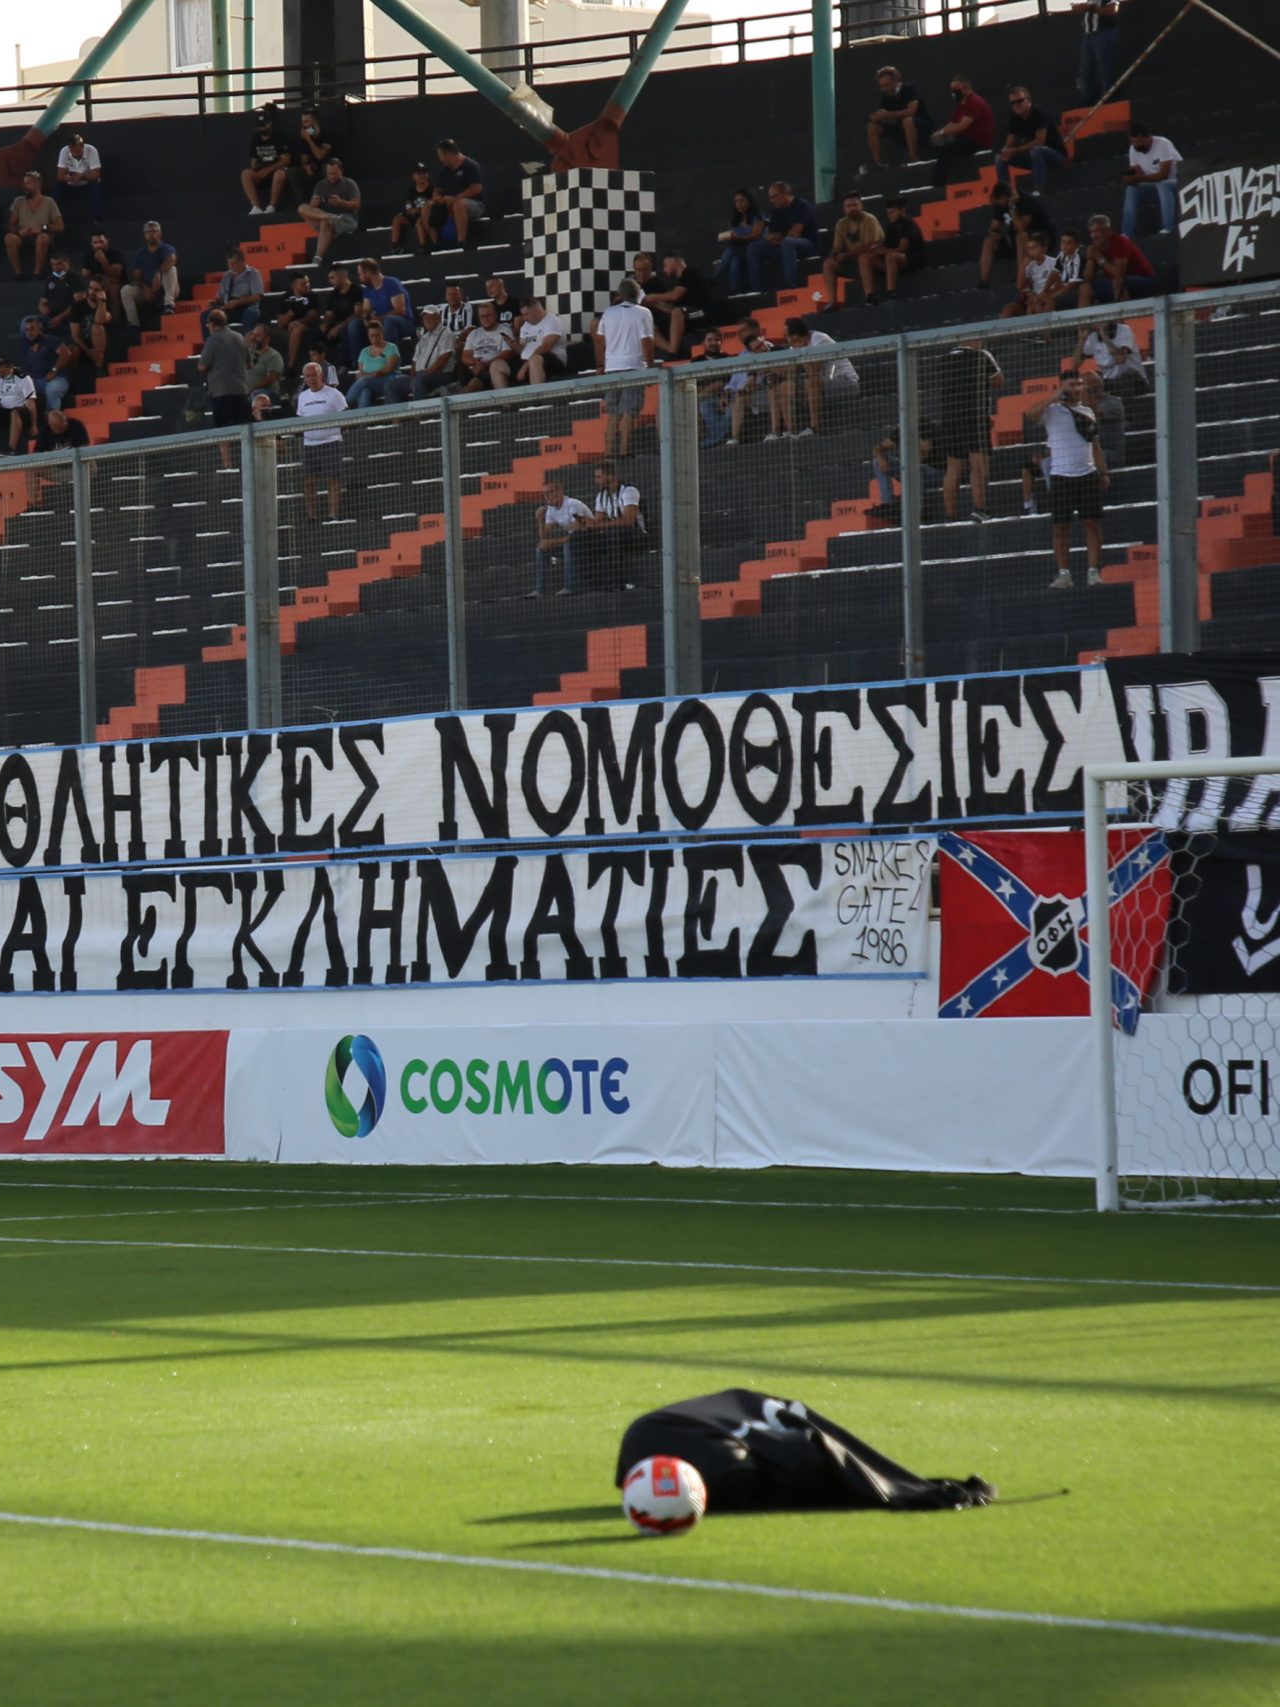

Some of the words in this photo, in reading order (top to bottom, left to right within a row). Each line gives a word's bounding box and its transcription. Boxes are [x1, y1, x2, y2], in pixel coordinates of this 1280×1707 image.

[434, 665, 1083, 841] ΝΟΜΟΘΕΣΙΕΣ
[117, 843, 821, 991] ΕΓΚΛΗΜΑΤΙΕΣ
[837, 884, 909, 925] GATE
[851, 925, 908, 966] 1986
[400, 1057, 630, 1115] COSMOTE
[1183, 1059, 1269, 1115] OFI
